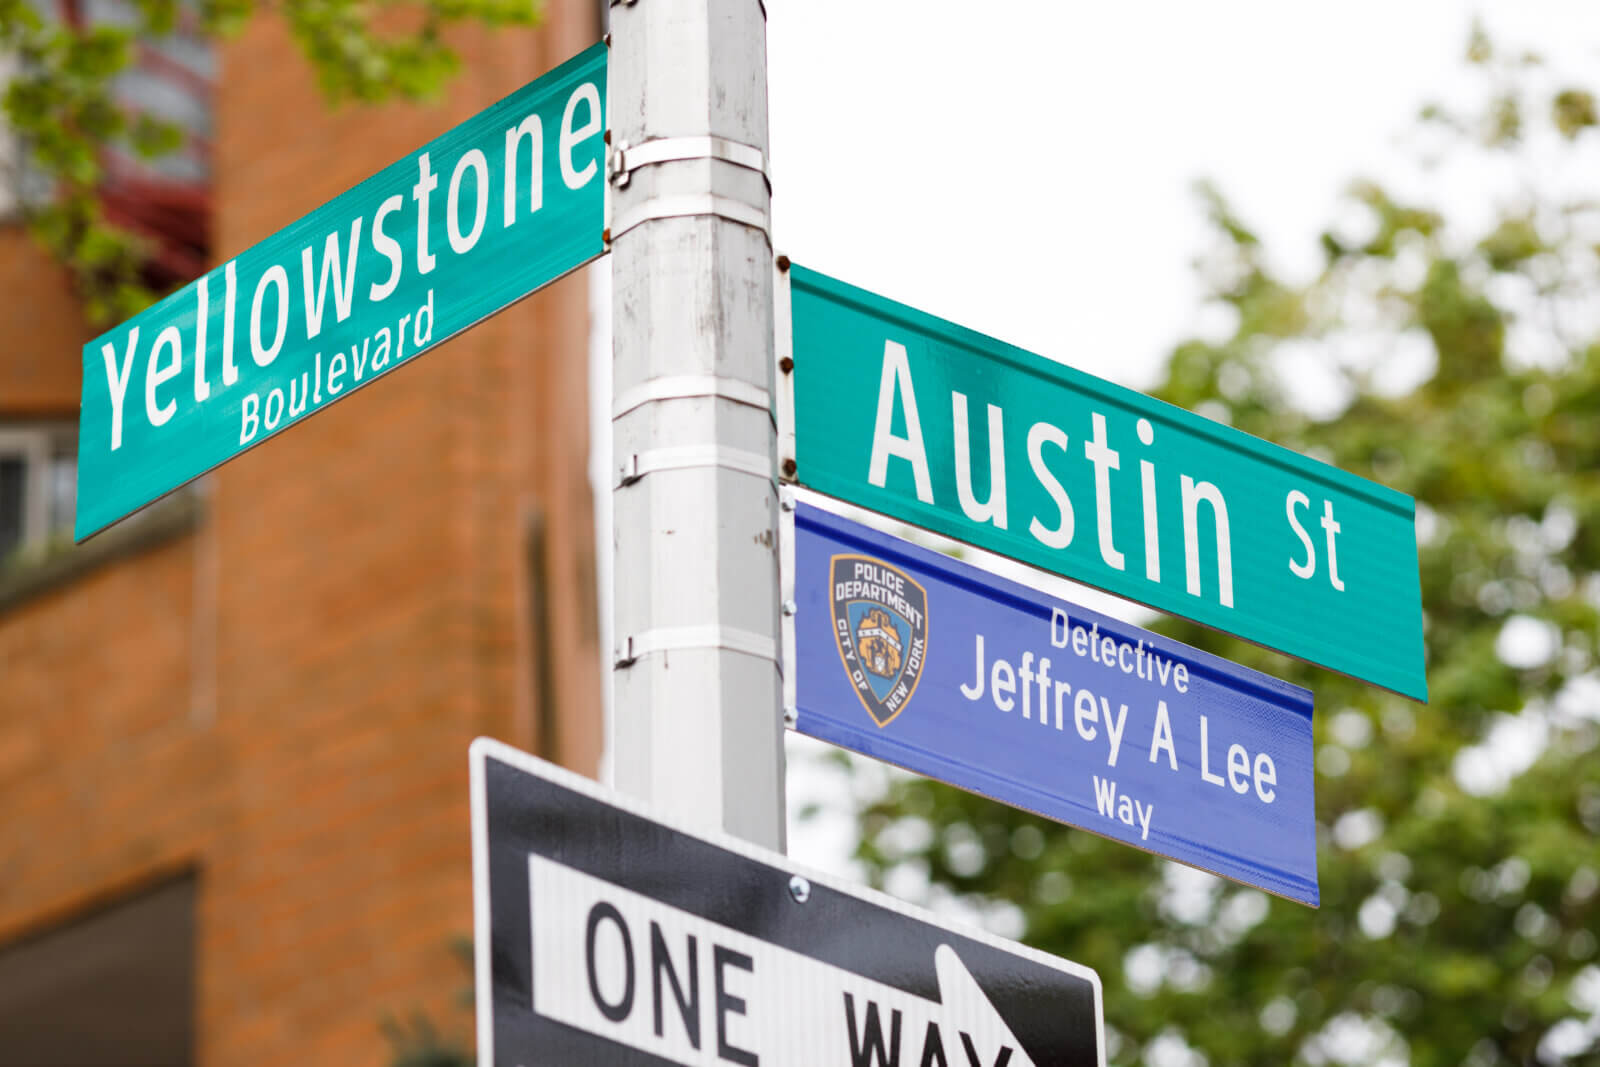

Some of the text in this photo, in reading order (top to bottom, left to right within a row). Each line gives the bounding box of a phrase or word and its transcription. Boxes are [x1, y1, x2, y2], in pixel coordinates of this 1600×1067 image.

[101, 82, 602, 451] Yellowstone
[239, 289, 435, 447] Boulevard
[868, 340, 1345, 609] Austin St
[835, 581, 923, 630] DEPARTMENT
[854, 563, 905, 597] POLICE
[837, 618, 869, 691] CITY OF
[885, 637, 924, 713] NEW YORK
[1050, 606, 1189, 694] Detective
[959, 634, 1278, 804] Jeffrey A Lee
[1093, 775, 1153, 841] Way
[585, 900, 759, 1067] ONE
